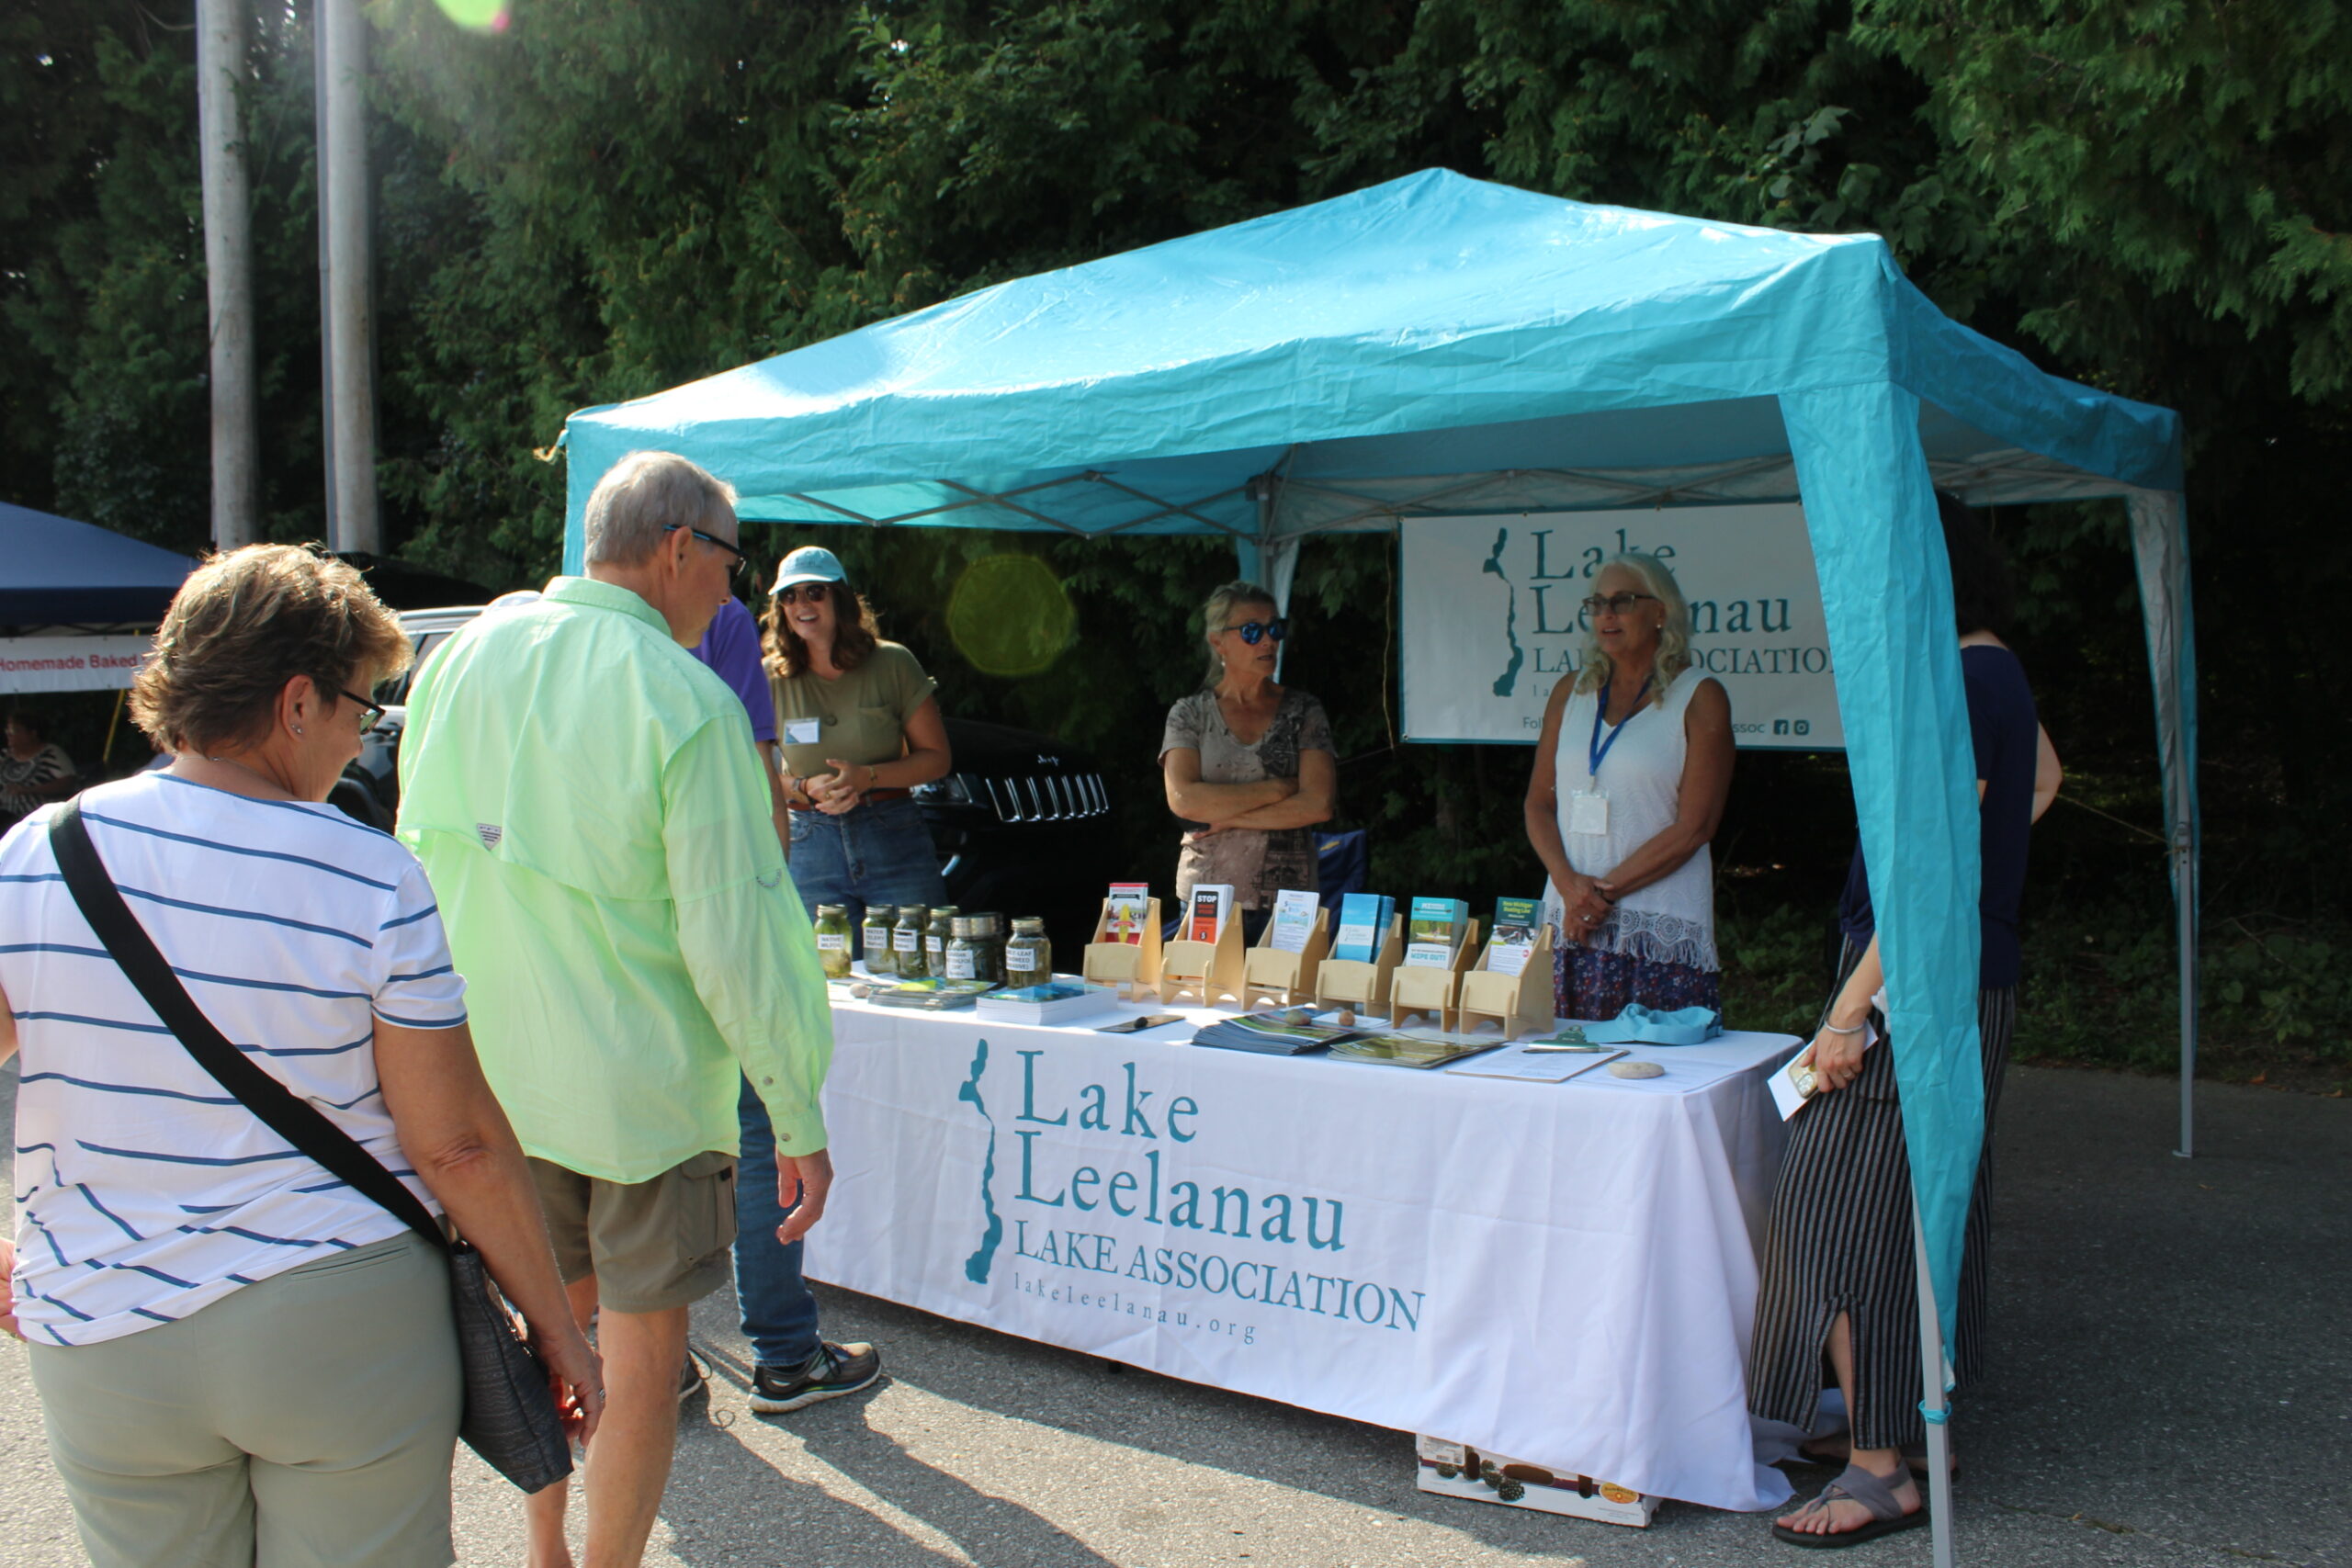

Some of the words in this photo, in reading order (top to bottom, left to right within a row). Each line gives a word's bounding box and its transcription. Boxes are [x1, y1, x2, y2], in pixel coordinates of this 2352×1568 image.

[89, 653, 137, 669] Baked
[1197, 895, 1217, 903] STOP
[1014, 1051, 1201, 1145] Lake
[1013, 1131, 1347, 1253] Leelanau
[1013, 1272, 1257, 1346] lakeleelanau.org
[1014, 1220, 1120, 1275] LAKE
[1125, 1245, 1427, 1333] ASSOCIATION
